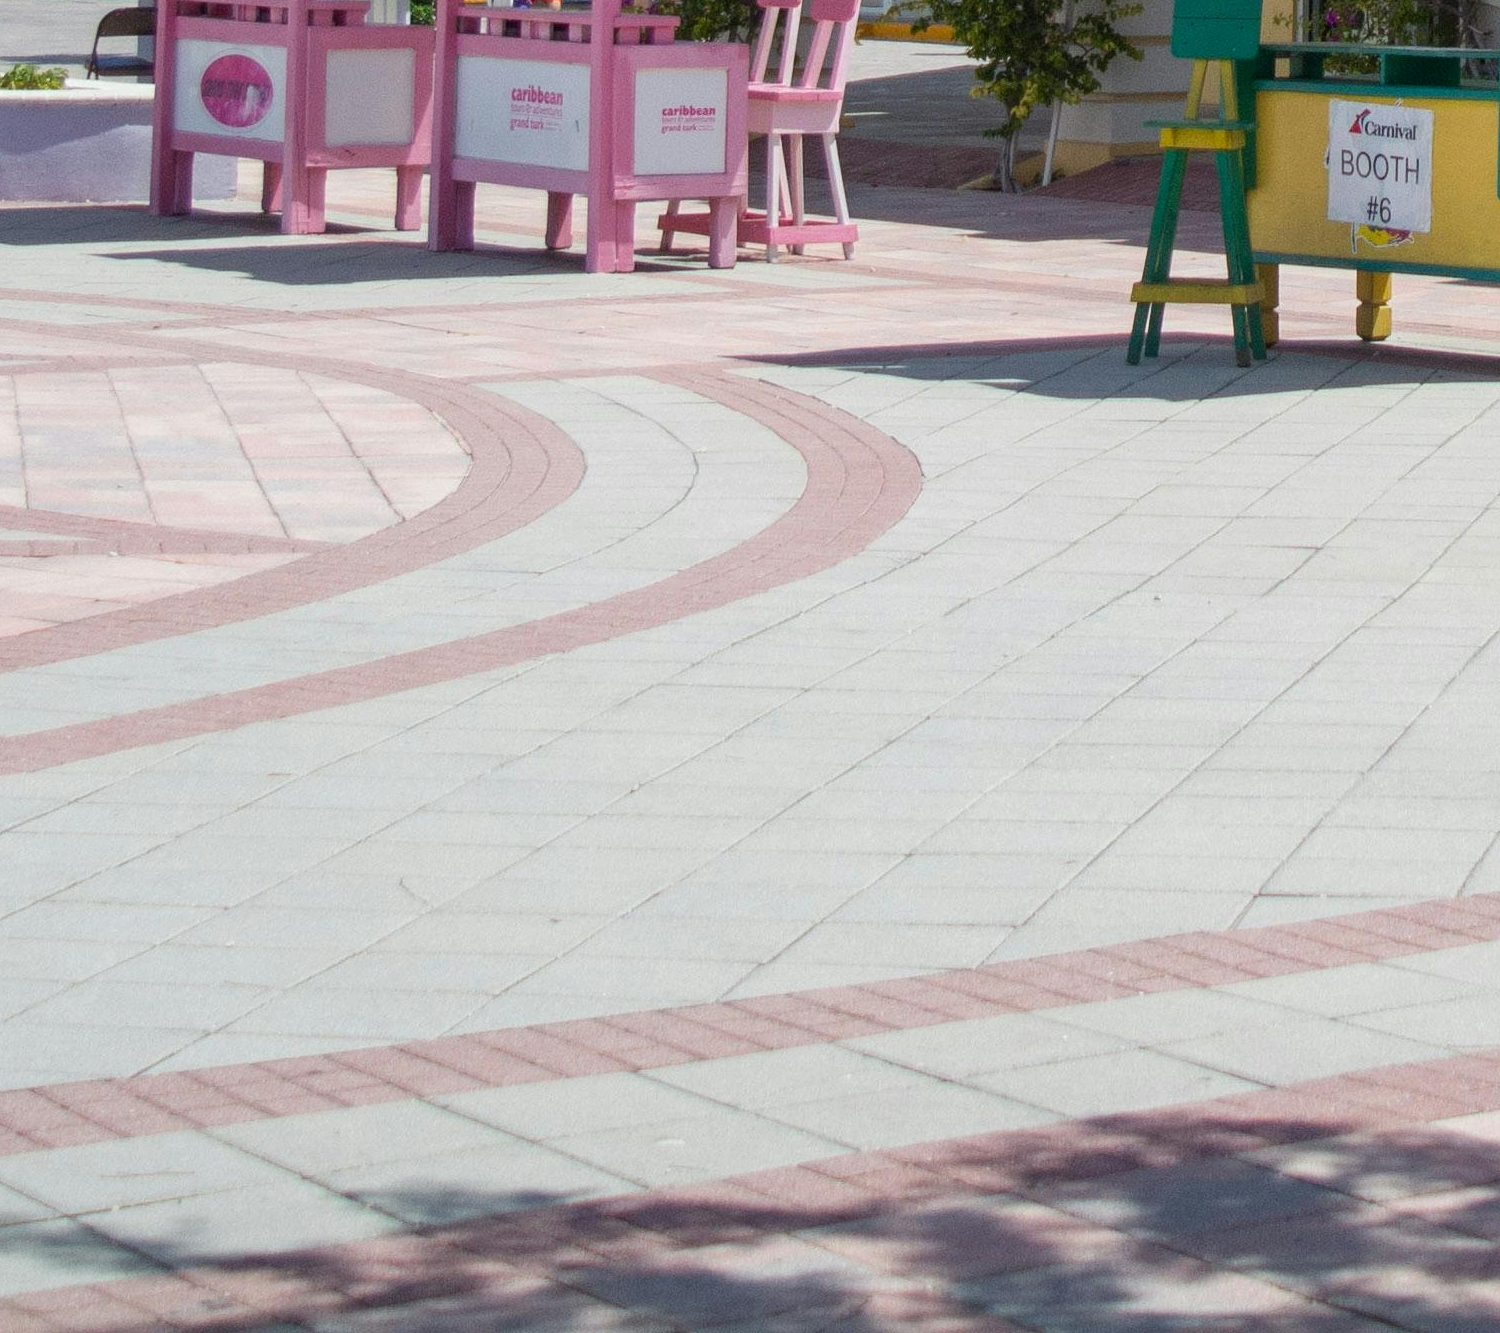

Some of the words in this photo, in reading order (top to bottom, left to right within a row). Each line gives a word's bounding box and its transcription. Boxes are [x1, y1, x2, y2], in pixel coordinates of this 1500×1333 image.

[511, 85, 564, 105] caribbean
[661, 105, 716, 116] caribbean
[1364, 120, 1418, 141] Carnival
[1341, 149, 1420, 185] BOOTH
[1366, 195, 1393, 224] #6
